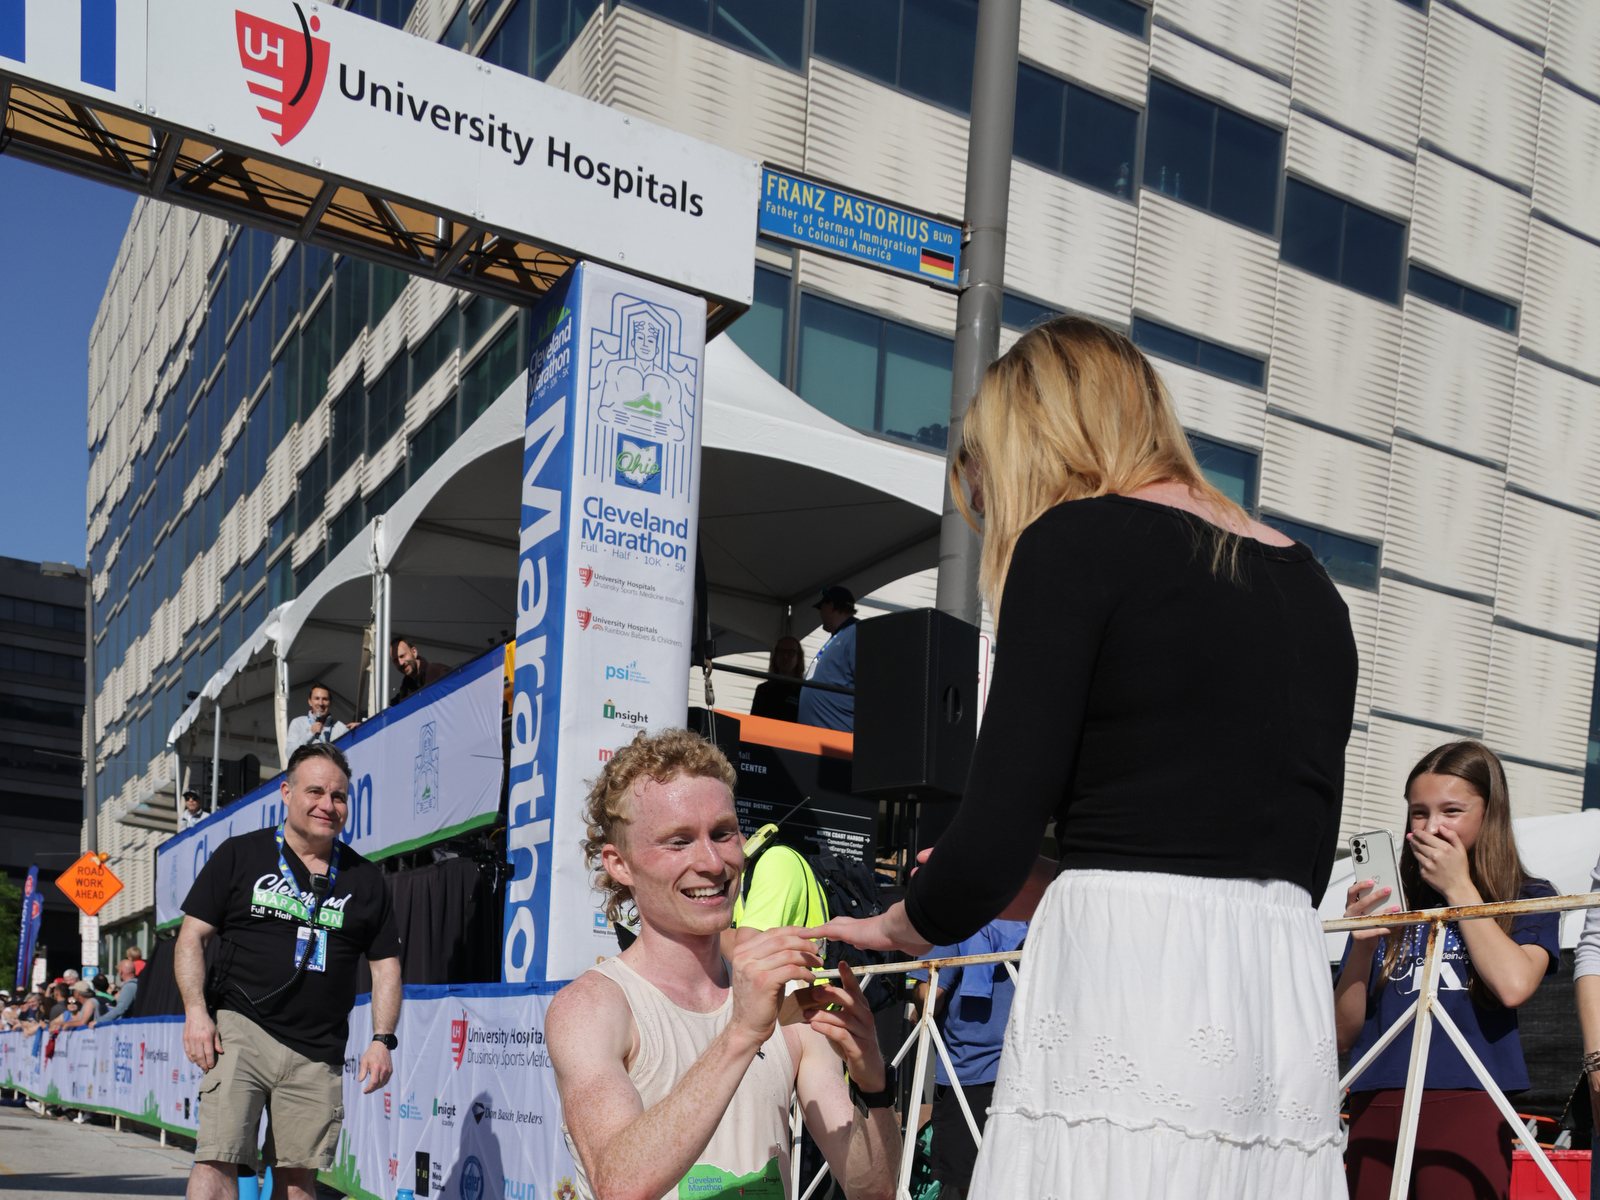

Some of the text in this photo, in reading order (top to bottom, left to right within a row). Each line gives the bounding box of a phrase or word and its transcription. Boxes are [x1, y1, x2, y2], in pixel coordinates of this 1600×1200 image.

[244, 25, 284, 68] UH
[339, 62, 704, 217] University Hospitals
[767, 173, 953, 244] FRANZ PASTORIUS BLVD
[765, 201, 918, 256] Father of German Immigration
[793, 222, 891, 261] to Colonial America
[529, 316, 572, 375] Cleveland
[528, 347, 570, 398] Marathon
[616, 451, 661, 475] Ohio
[583, 496, 688, 540] Cleveland
[581, 518, 686, 562] Marathon
[580, 542, 686, 573] Full Half 10K 5K
[593, 573, 656, 592] University Hospitals
[593, 581, 685, 606] Drusinsky Sports Medicine Institute
[592, 615, 658, 634] University Hospitals
[604, 626, 630, 637] Rainbow
[630, 630, 650, 641] Babies
[606, 665, 629, 680] psi
[504, 396, 566, 982] Maratho
[603, 703, 649, 724] Insight
[740, 762, 767, 775] CENTER
[753, 803, 773, 811] DISTRICT
[816, 830, 864, 842] NORTH COAST HARBOR
[827, 838, 850, 847] Convention
[78, 866, 104, 876] ROAD
[75, 878, 104, 888] WORK
[75, 890, 104, 900] AHEAD
[251, 905, 265, 915] Full
[254, 892, 342, 925] MARATON
[295, 962, 322, 971] OCIAL
[452, 1025, 461, 1038] UH
[468, 1027, 546, 1049] University Hospita
[467, 1048, 499, 1069] Drusinsky
[501, 1049, 525, 1069] Sports
[399, 1099, 410, 1119] si
[484, 1107, 497, 1120] Don
[688, 1176, 722, 1184] Cleveland
[689, 1183, 723, 1192] Marathon
